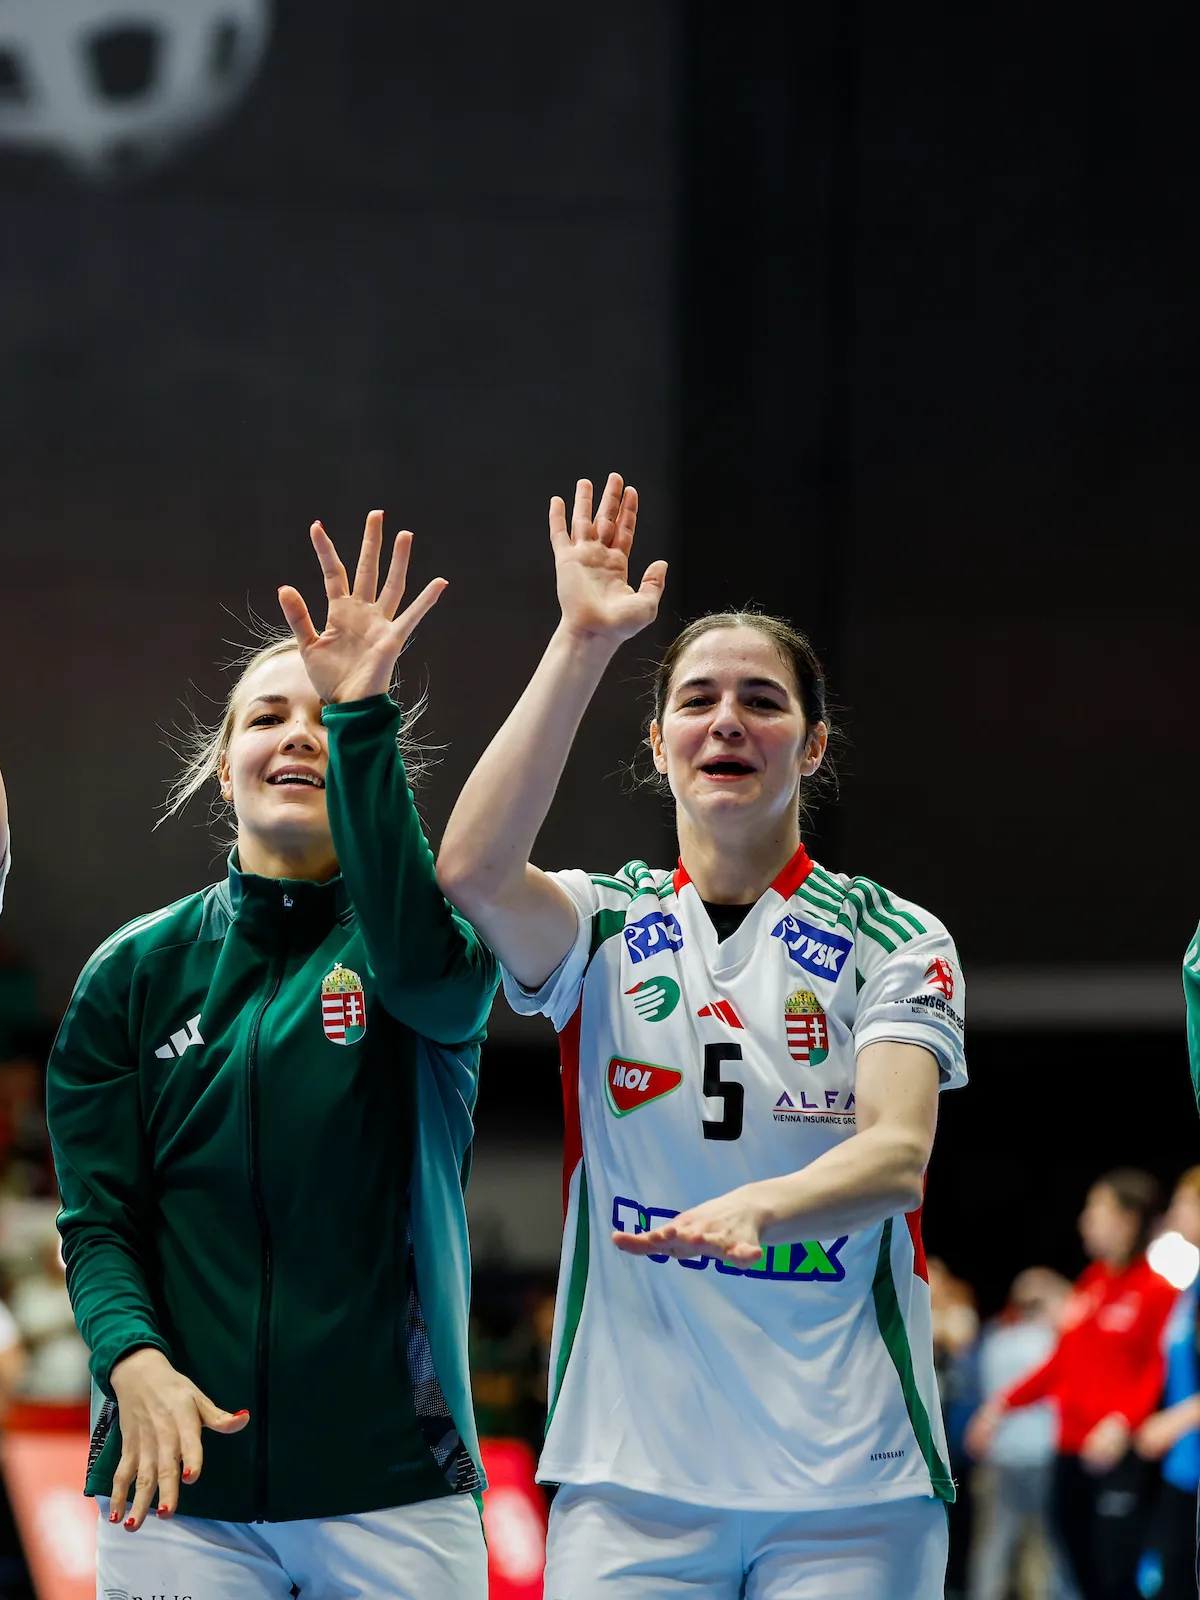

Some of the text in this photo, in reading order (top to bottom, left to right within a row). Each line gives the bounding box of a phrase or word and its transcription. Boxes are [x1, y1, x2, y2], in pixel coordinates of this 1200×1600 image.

[788, 934, 846, 972] JYSK
[612, 1065, 652, 1092] MOL
[701, 1042, 745, 1141] 5
[773, 1113, 801, 1123] VIENNA
[802, 1115, 841, 1125] INSURANCE
[870, 1450, 905, 1461] AEROREADY
